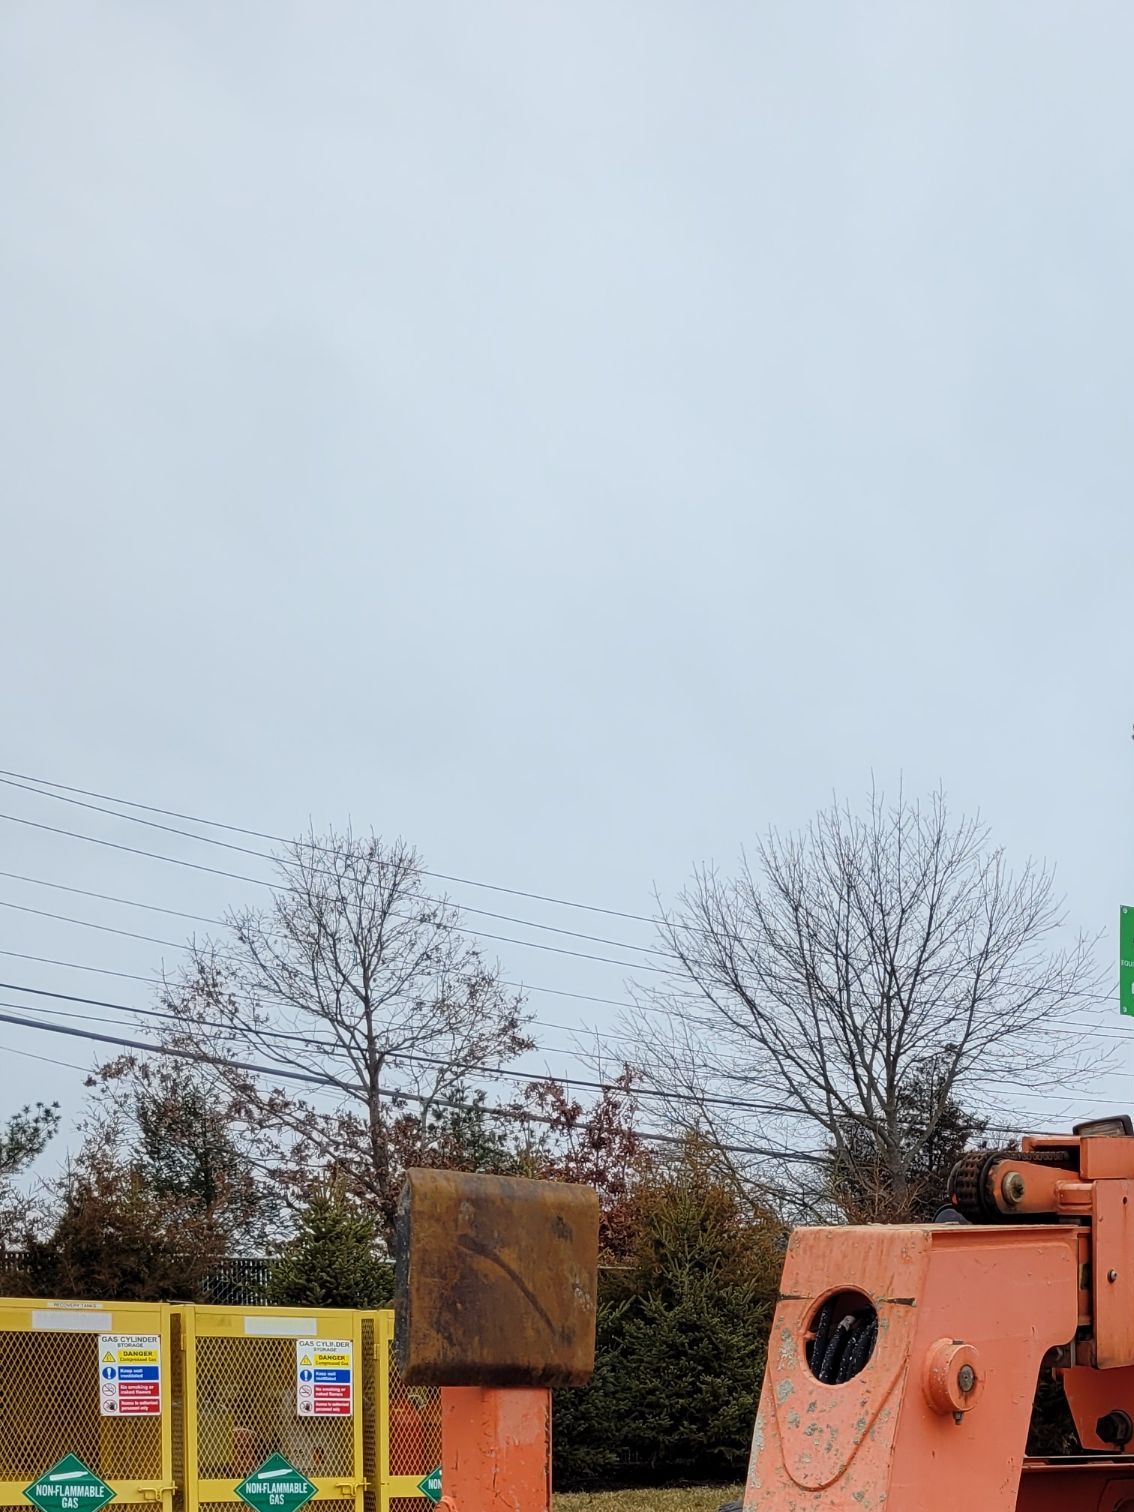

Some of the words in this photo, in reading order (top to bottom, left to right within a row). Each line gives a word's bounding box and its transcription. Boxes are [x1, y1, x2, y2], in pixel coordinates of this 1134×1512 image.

[35, 1484, 105, 1498] NON-FLAMMABLE
[246, 1482, 308, 1494] NON-FLAMMABLE
[61, 1497, 79, 1509] GAS
[269, 1494, 285, 1505] GAS
